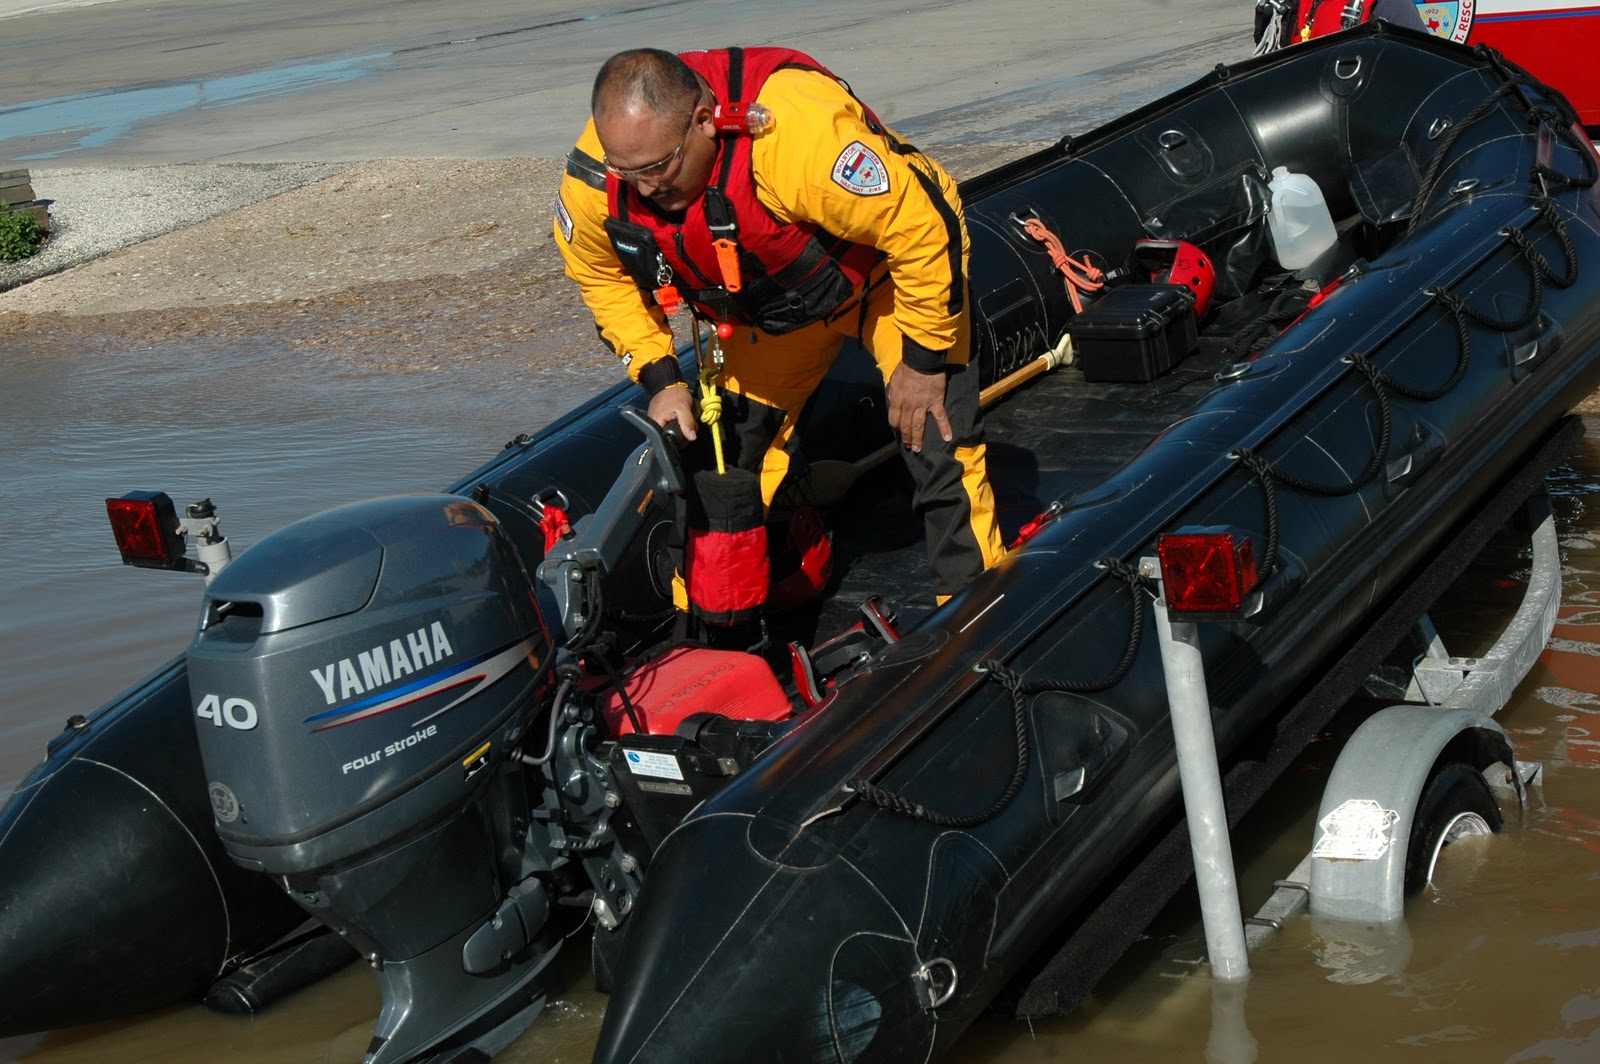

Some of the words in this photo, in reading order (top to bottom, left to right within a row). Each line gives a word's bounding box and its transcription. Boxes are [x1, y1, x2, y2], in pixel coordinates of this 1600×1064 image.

[1458, 0, 1472, 32] RESC
[835, 146, 857, 174] WHARTON
[310, 620, 454, 705] YAMAHA
[710, 662, 736, 678] Four
[672, 677, 712, 698] Stroke
[196, 693, 259, 731] 40
[648, 699, 674, 716] Only
